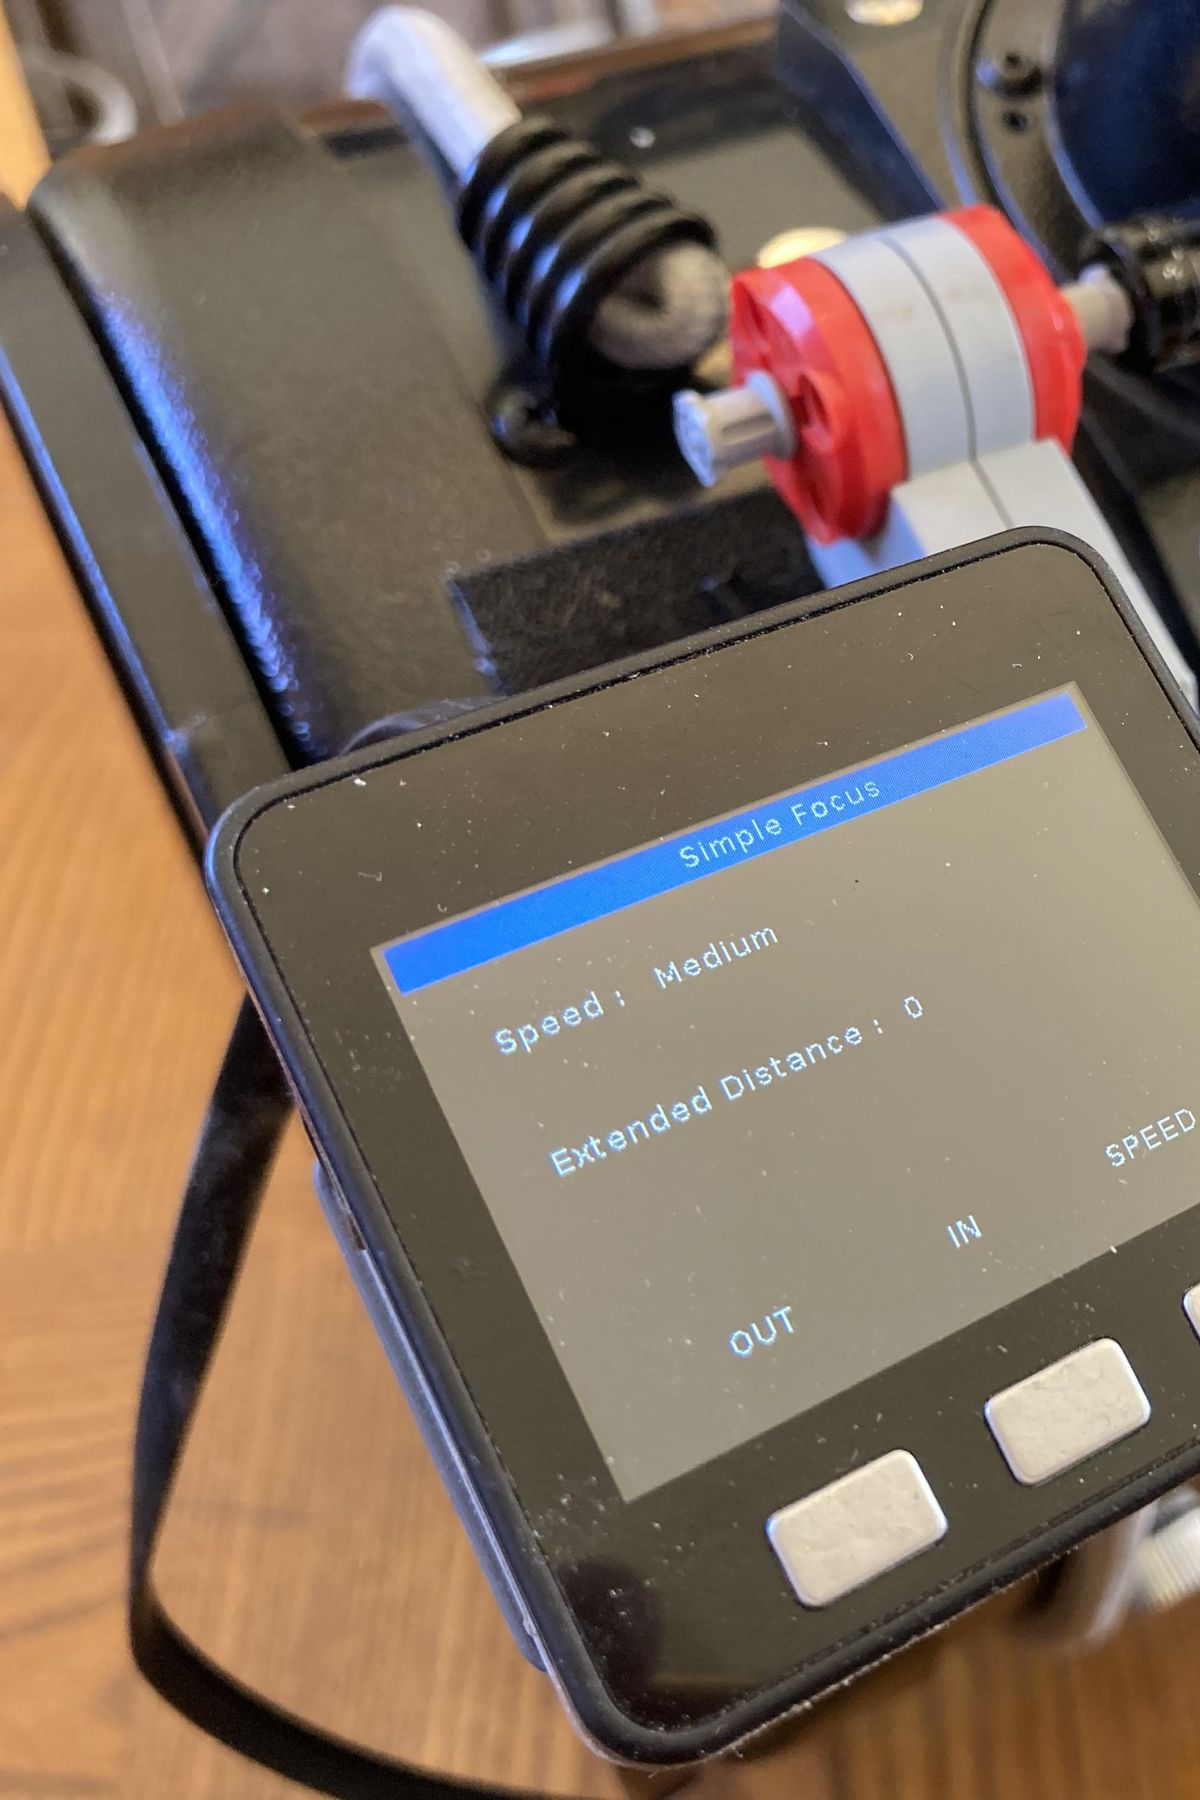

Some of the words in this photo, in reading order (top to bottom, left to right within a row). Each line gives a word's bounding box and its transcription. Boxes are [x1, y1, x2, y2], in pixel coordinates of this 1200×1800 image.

[678, 818, 783, 868] Simple
[790, 781, 880, 826] Focus
[653, 927, 779, 990] Medium
[548, 1085, 713, 1178] Extended
[903, 995, 924, 1020] 0
[1104, 1108, 1197, 1168] SPEED
[946, 1214, 983, 1249] IN
[728, 1305, 795, 1359] OUT
